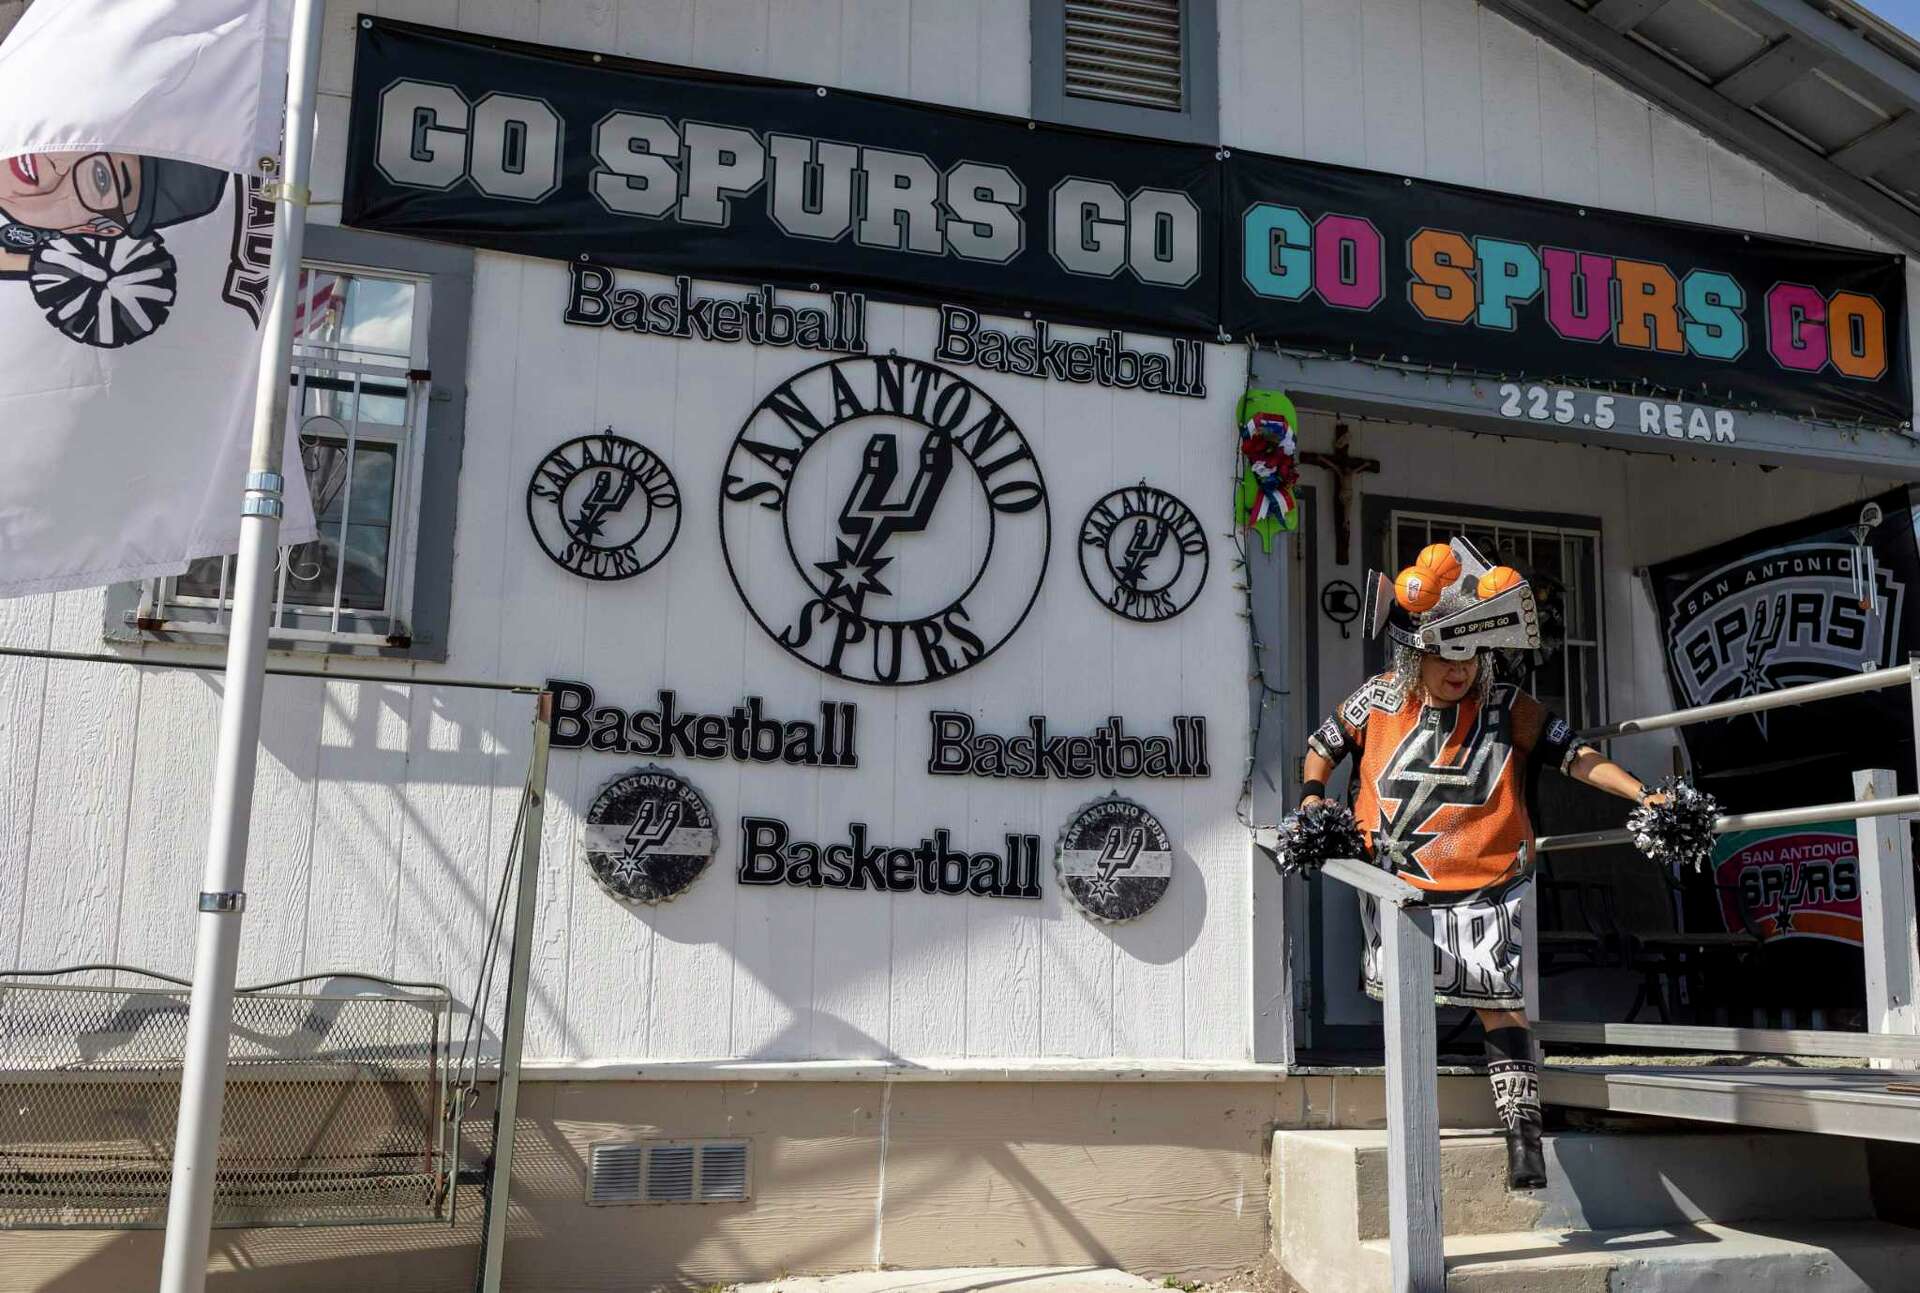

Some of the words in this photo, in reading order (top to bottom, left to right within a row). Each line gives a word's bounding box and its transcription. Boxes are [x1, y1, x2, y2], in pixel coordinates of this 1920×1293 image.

[374, 76, 566, 204] GO
[588, 108, 1027, 267] SPURS
[1049, 174, 1202, 290] GO
[564, 261, 868, 354] Basketball
[1241, 201, 1387, 313] GO
[1406, 226, 1749, 363] SPURS
[1763, 280, 1889, 382] GO
[935, 304, 1206, 398] Basketball
[725, 384, 827, 512] SAN
[831, 358, 1044, 514] ANTONIO
[1499, 383, 1615, 429] 225.5
[1639, 401, 1736, 442] REAR
[532, 449, 577, 504] SAN
[582, 439, 678, 509] ANTONIO
[1081, 499, 1120, 549] SAN
[1122, 488, 1206, 556] ANTONIO
[559, 540, 641, 577] SPURS
[1687, 580, 1729, 615] SAN
[1745, 557, 1851, 585] ANTONIO
[1108, 585, 1178, 618] SPURS
[1454, 626, 1466, 635] GO
[1496, 617, 1509, 626] GO
[778, 598, 986, 682] SPURS
[1685, 592, 1866, 687] SPURS
[547, 679, 858, 768] Basketball
[928, 710, 1210, 778] Basketball
[591, 796, 610, 824] SAN
[613, 775, 677, 798] ANTONIO
[679, 786, 710, 827] SPURS
[1066, 822, 1084, 850] SAN
[1083, 803, 1139, 825] ANTONIO
[1140, 813, 1169, 850] SPURS
[739, 816, 1041, 900] Basketball
[1740, 857, 1859, 908] SPURS
[1742, 851, 1774, 864] SAN
[1780, 841, 1854, 860] ANTONIO
